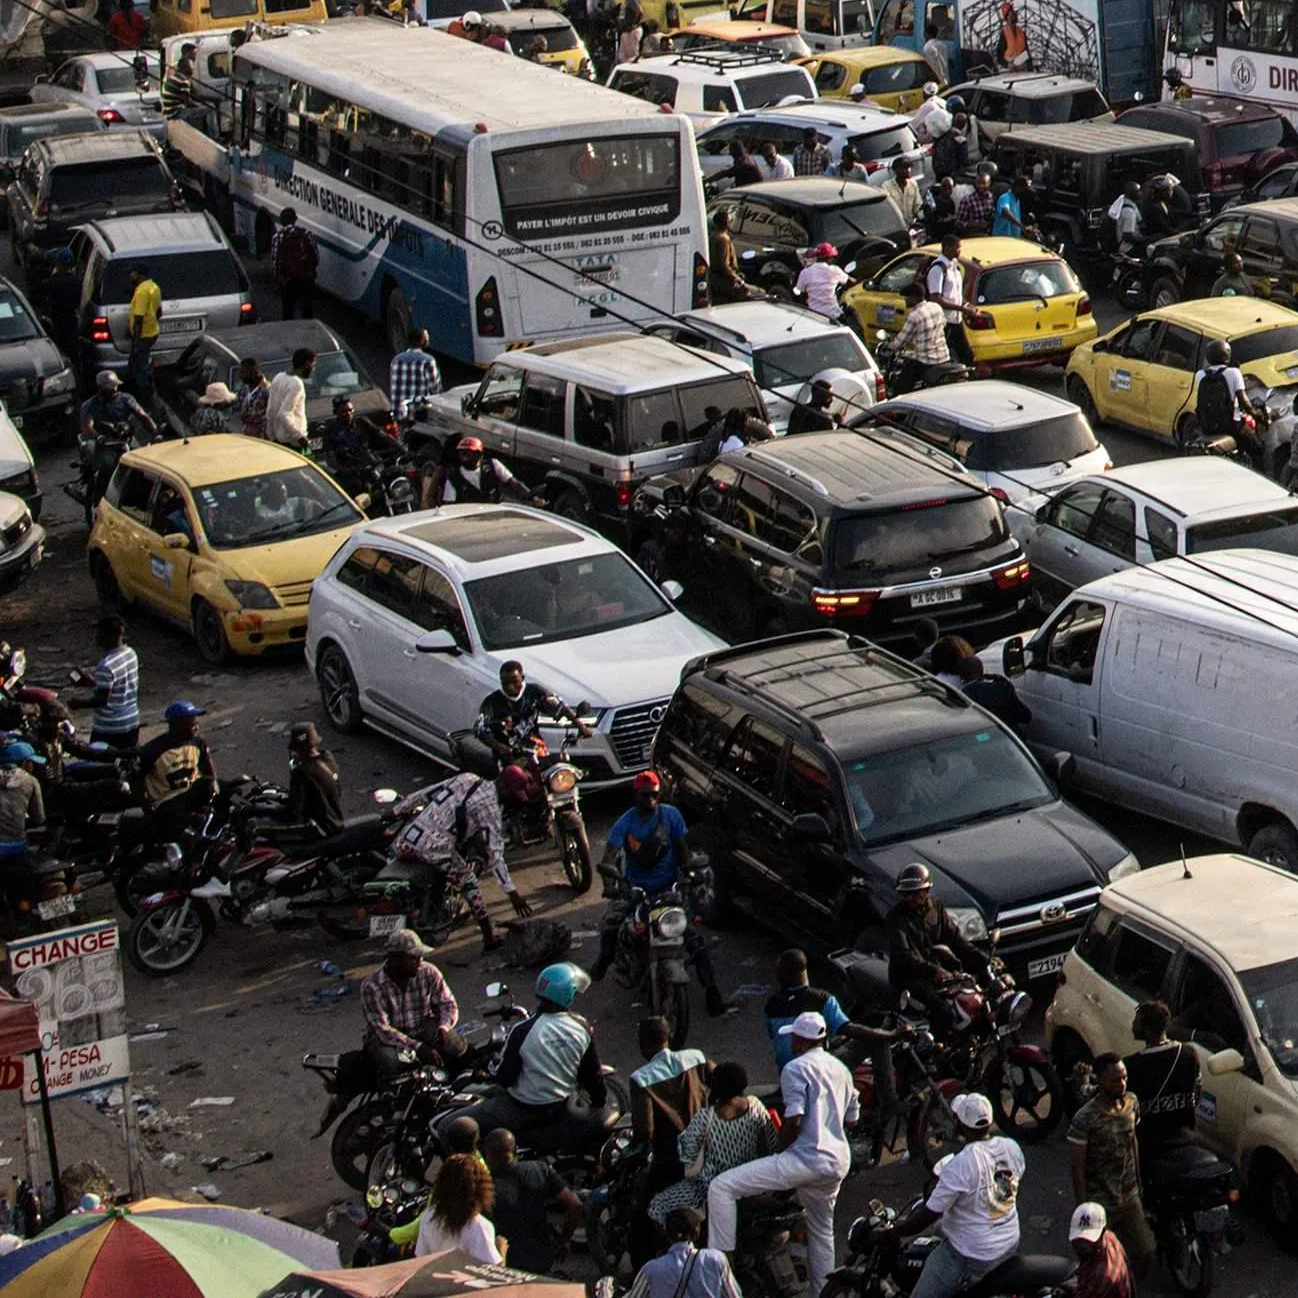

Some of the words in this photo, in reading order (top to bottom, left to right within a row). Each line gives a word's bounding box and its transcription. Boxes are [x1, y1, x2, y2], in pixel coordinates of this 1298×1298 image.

[274, 164, 319, 207] DIRECTION
[319, 187, 366, 231] GENERALE
[367, 208, 387, 241] DES
[517, 220, 544, 231] PAYER
[578, 213, 593, 225] EST
[593, 211, 607, 223] UN
[607, 208, 637, 222] DEVOIR
[638, 204, 670, 217] CIVIQUE
[575, 254, 616, 267] TATA
[14, 928, 116, 969] CHANGE
[30, 1071, 73, 1095] OANGE
[79, 1062, 113, 1083] MONEY
